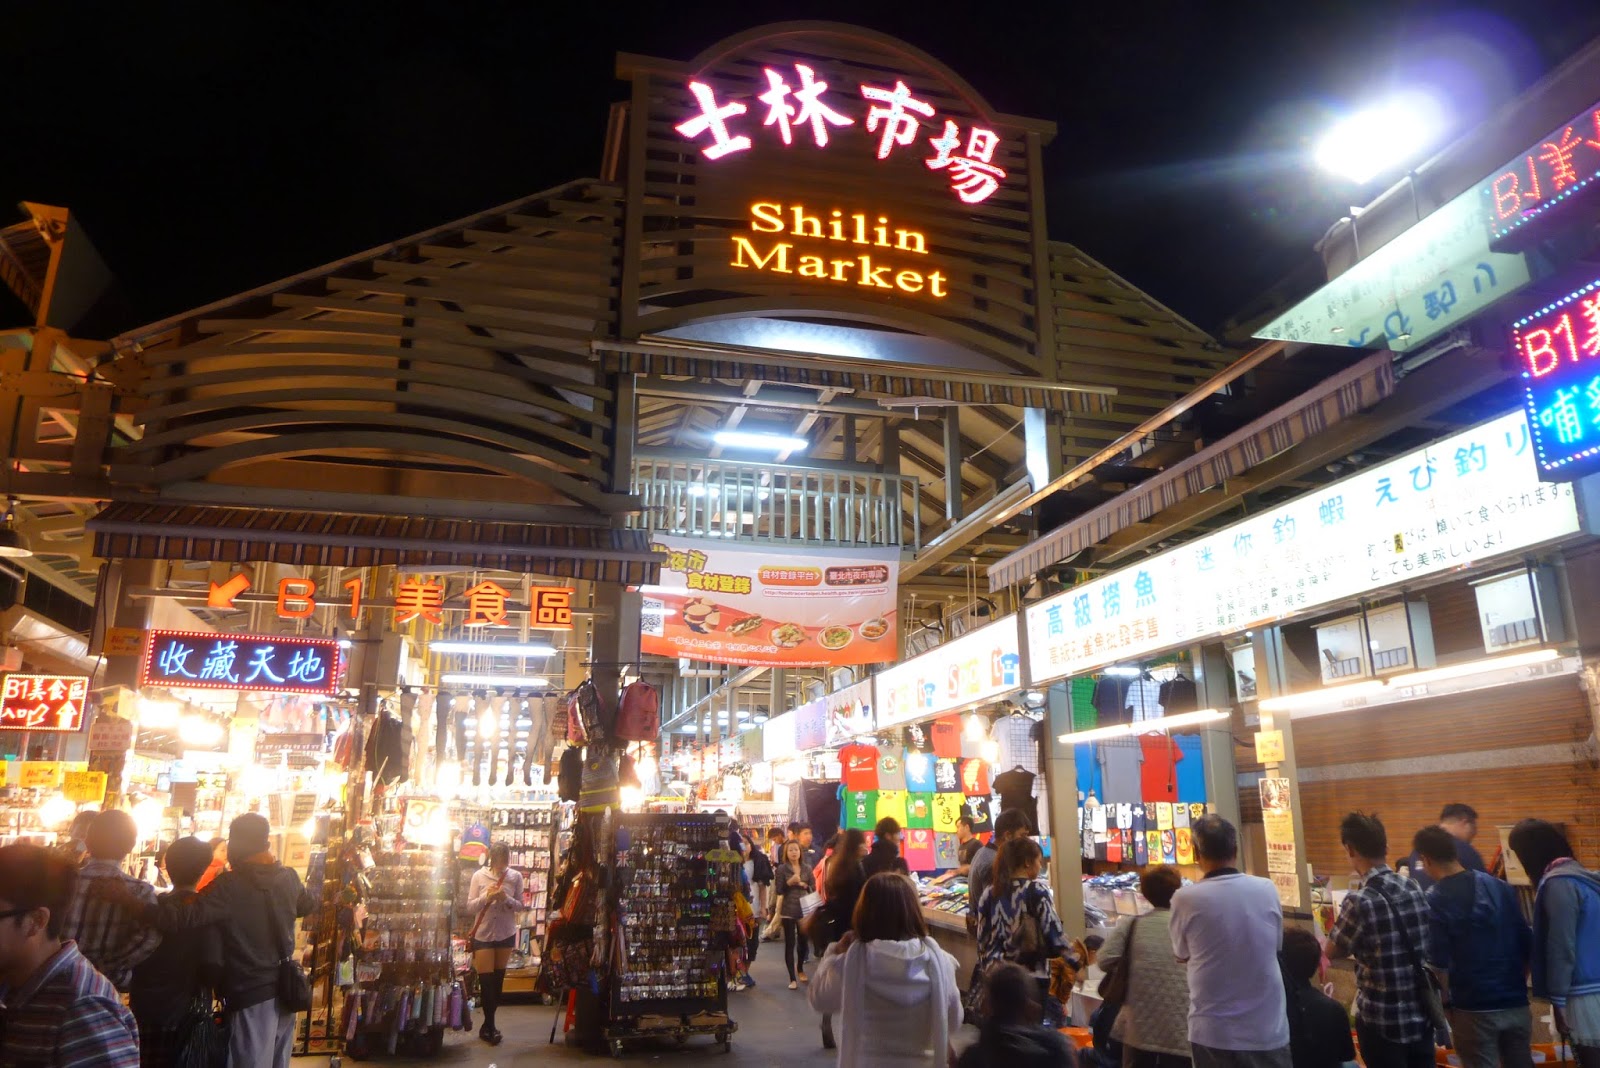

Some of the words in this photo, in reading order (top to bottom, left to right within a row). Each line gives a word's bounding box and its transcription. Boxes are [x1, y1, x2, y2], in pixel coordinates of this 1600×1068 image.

[675, 63, 1006, 203] 士林市場
[750, 203, 929, 255] Shilin
[730, 236, 947, 297] Market
[1196, 494, 1345, 572] 迷你釣蝦
[1376, 424, 1528, 507] えび釣り
[1046, 569, 1157, 638] 高級撈魚
[5, 677, 85, 701] B1美食區
[160, 640, 326, 684] 收藏天地
[2, 706, 27, 719] 入口
